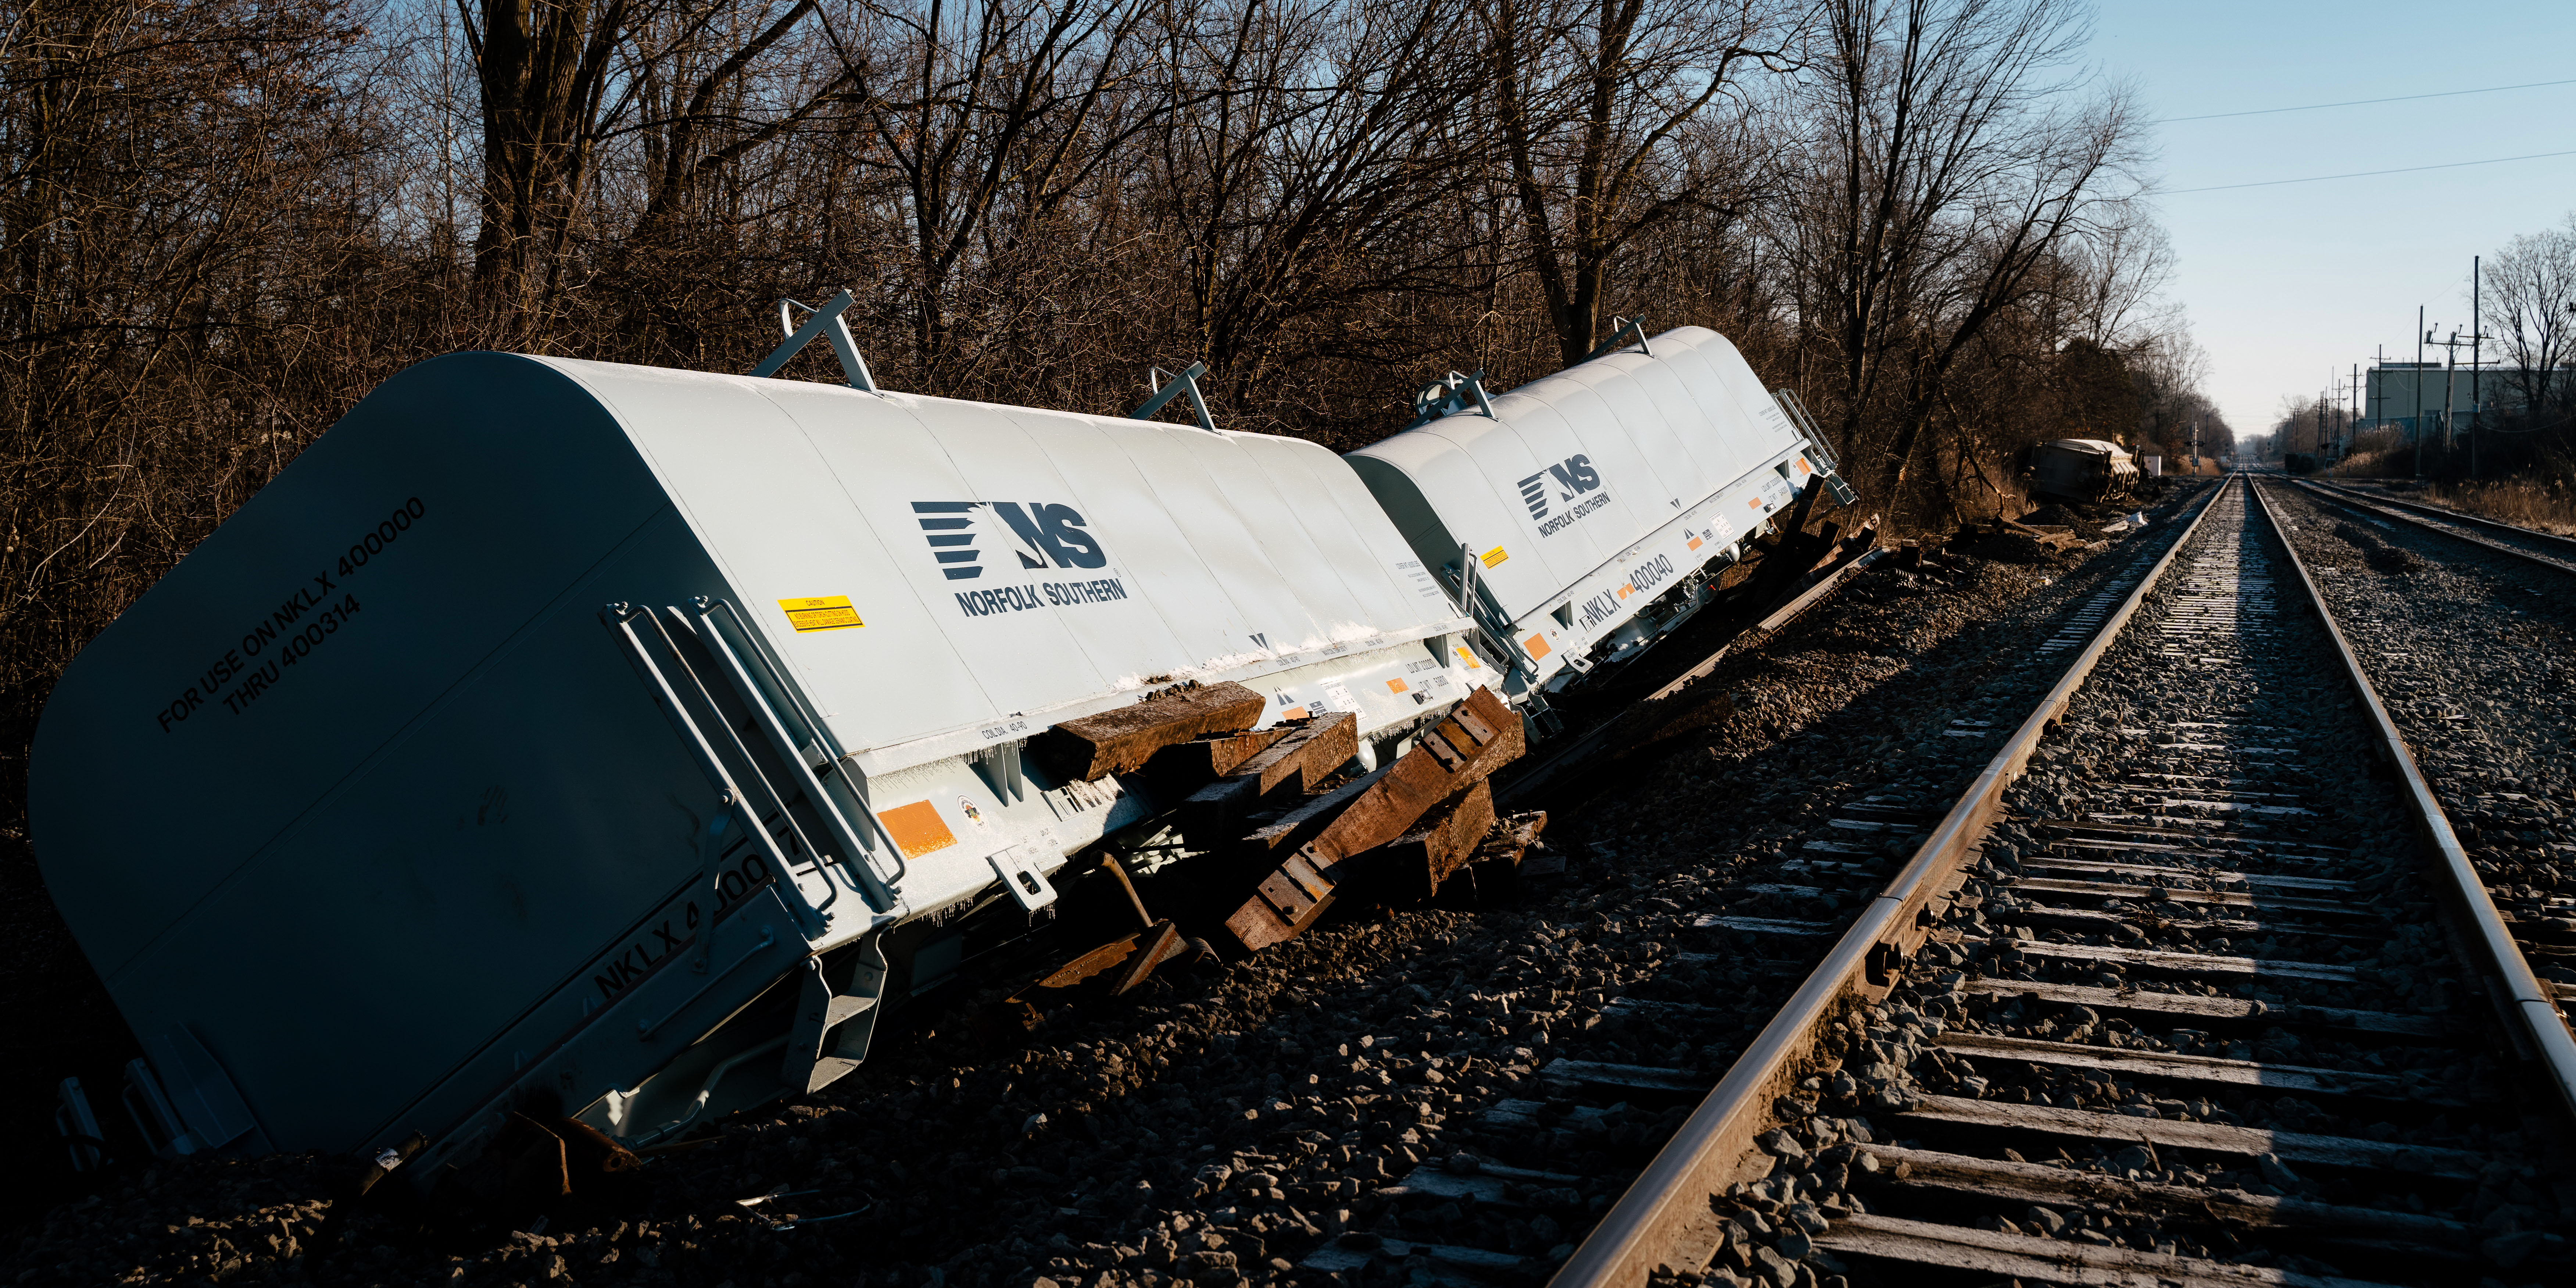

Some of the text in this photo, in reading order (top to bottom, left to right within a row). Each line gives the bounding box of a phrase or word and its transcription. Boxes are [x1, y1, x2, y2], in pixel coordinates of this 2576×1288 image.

[1549, 454, 1600, 502] NS
[992, 502, 1106, 569] NS
[1538, 491, 1610, 538] NORFOLK SOUTHERN
[955, 578, 1128, 617] NORFOLK SOUTHERN
[1582, 554, 1673, 625] NKLX 400040
[157, 497, 425, 733] FOR USE ON NKLX 400000
[223, 593, 361, 715] THRU 400314
[1405, 658, 1436, 673] LD LMT 232200
[1418, 675, 1449, 691] LT WT 53800
[982, 728, 998, 740] COIL
[1009, 721, 1027, 732] 40-90
[594, 826, 800, 999] NKLX 4007
